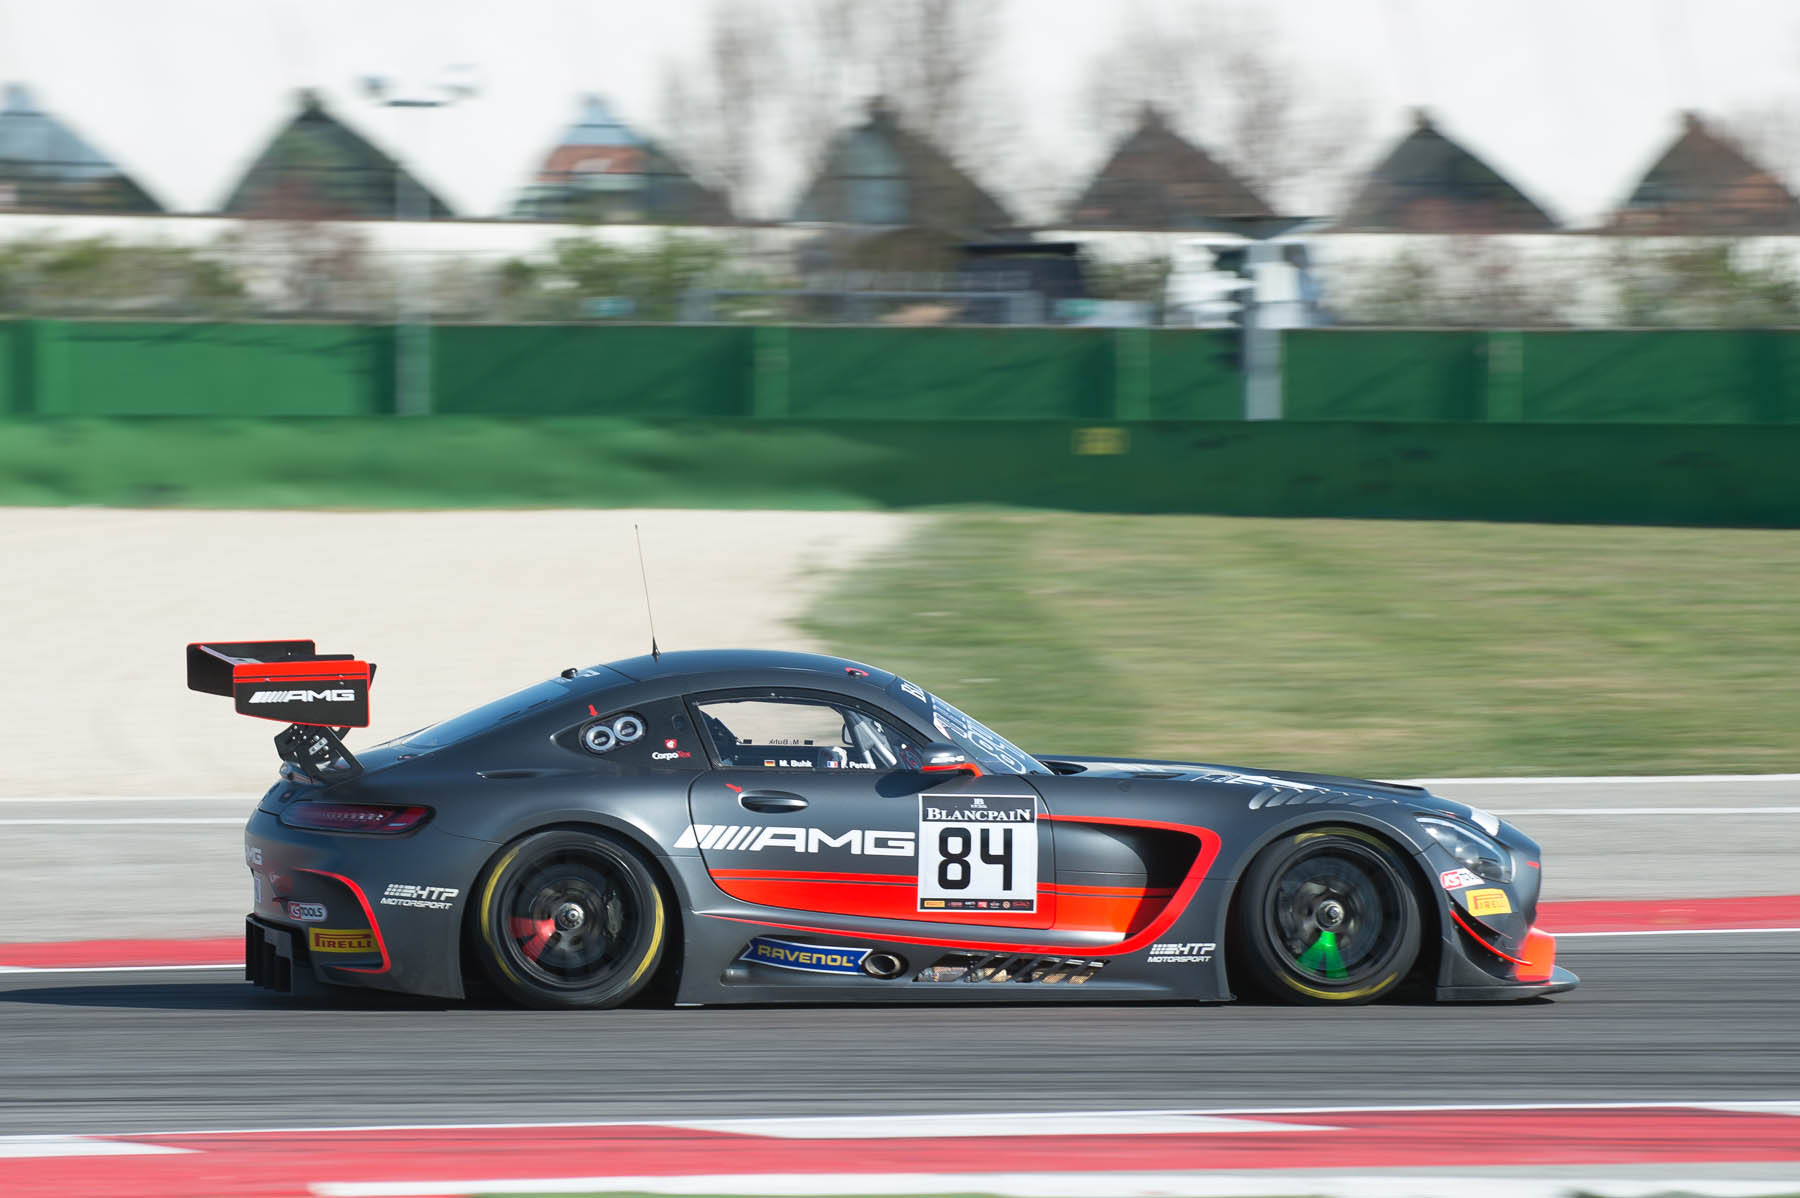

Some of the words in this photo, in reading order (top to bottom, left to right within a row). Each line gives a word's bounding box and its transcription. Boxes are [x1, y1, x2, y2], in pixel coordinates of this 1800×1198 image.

[284, 690, 355, 702] AMG
[791, 760, 813, 768] Buhk
[926, 807, 1031, 821] BLANCPAIN
[749, 827, 916, 857] AMG
[938, 827, 1013, 891] 84
[411, 884, 460, 901] HTP
[380, 897, 453, 910] MOTORSPORT
[314, 932, 373, 949] PIRELLI
[757, 944, 854, 967] RAVENOL
[1174, 943, 1217, 955] HTP
[1146, 955, 1212, 963] MOTORSPORT
